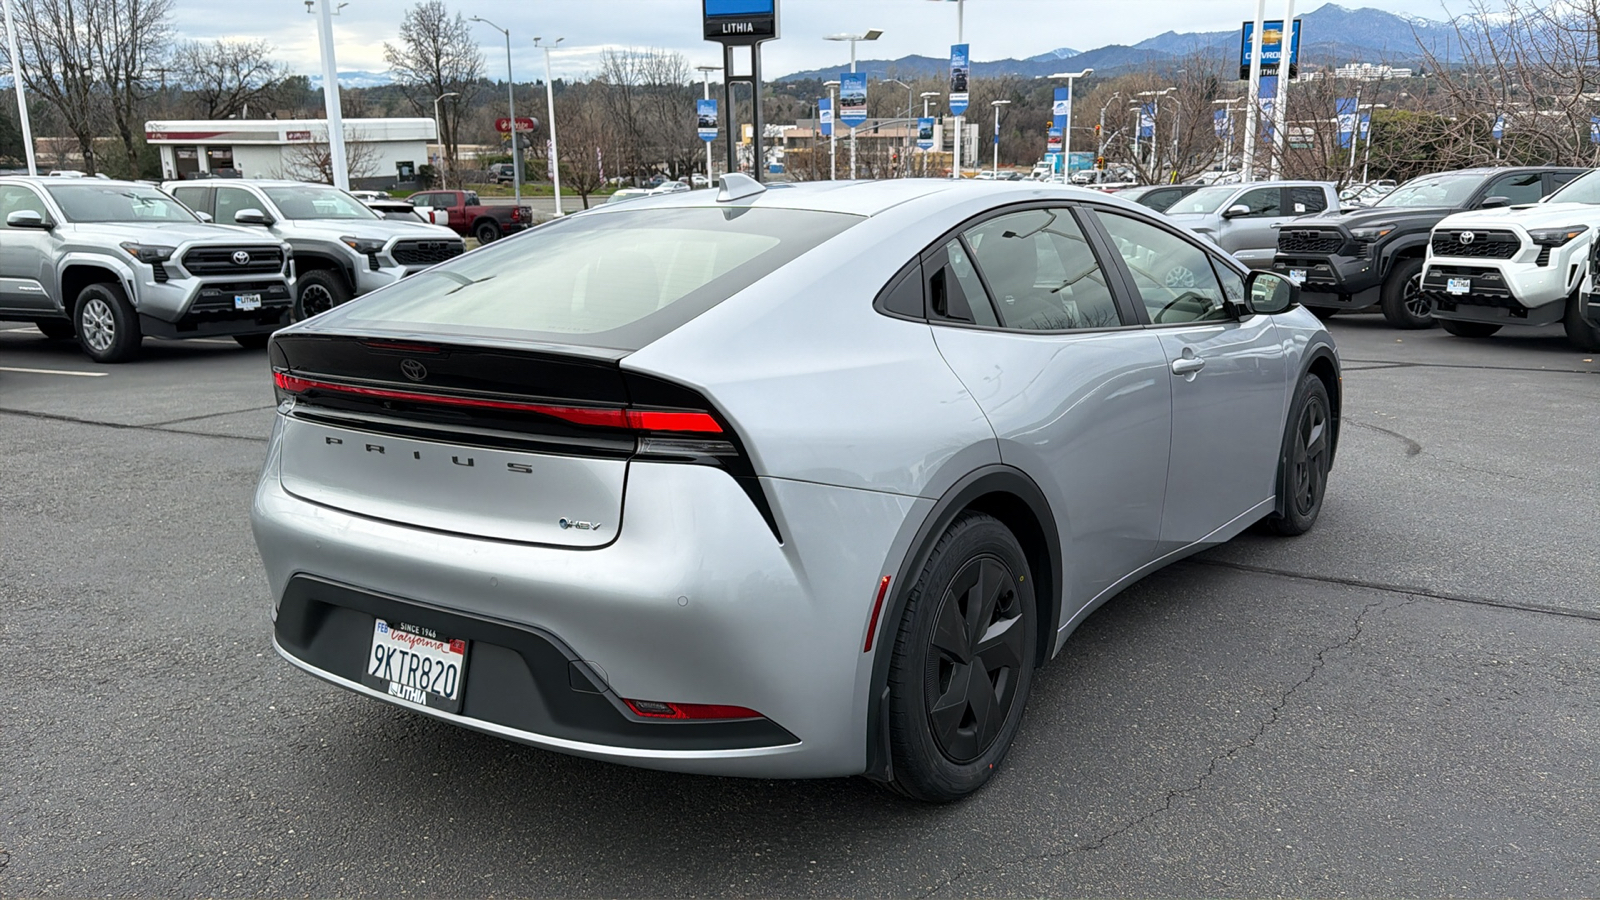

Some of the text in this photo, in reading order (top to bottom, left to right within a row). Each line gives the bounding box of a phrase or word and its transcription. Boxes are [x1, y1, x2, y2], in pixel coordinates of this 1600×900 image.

[722, 23, 754, 33] LITHIA
[326, 437, 533, 473] PRIUS
[568, 520, 602, 530] HEV
[377, 622, 388, 633] FEB
[400, 622, 437, 638] SINCE 1946
[391, 629, 449, 654] California
[372, 644, 457, 698] 9KTR820
[397, 684, 427, 705] LITHIA
